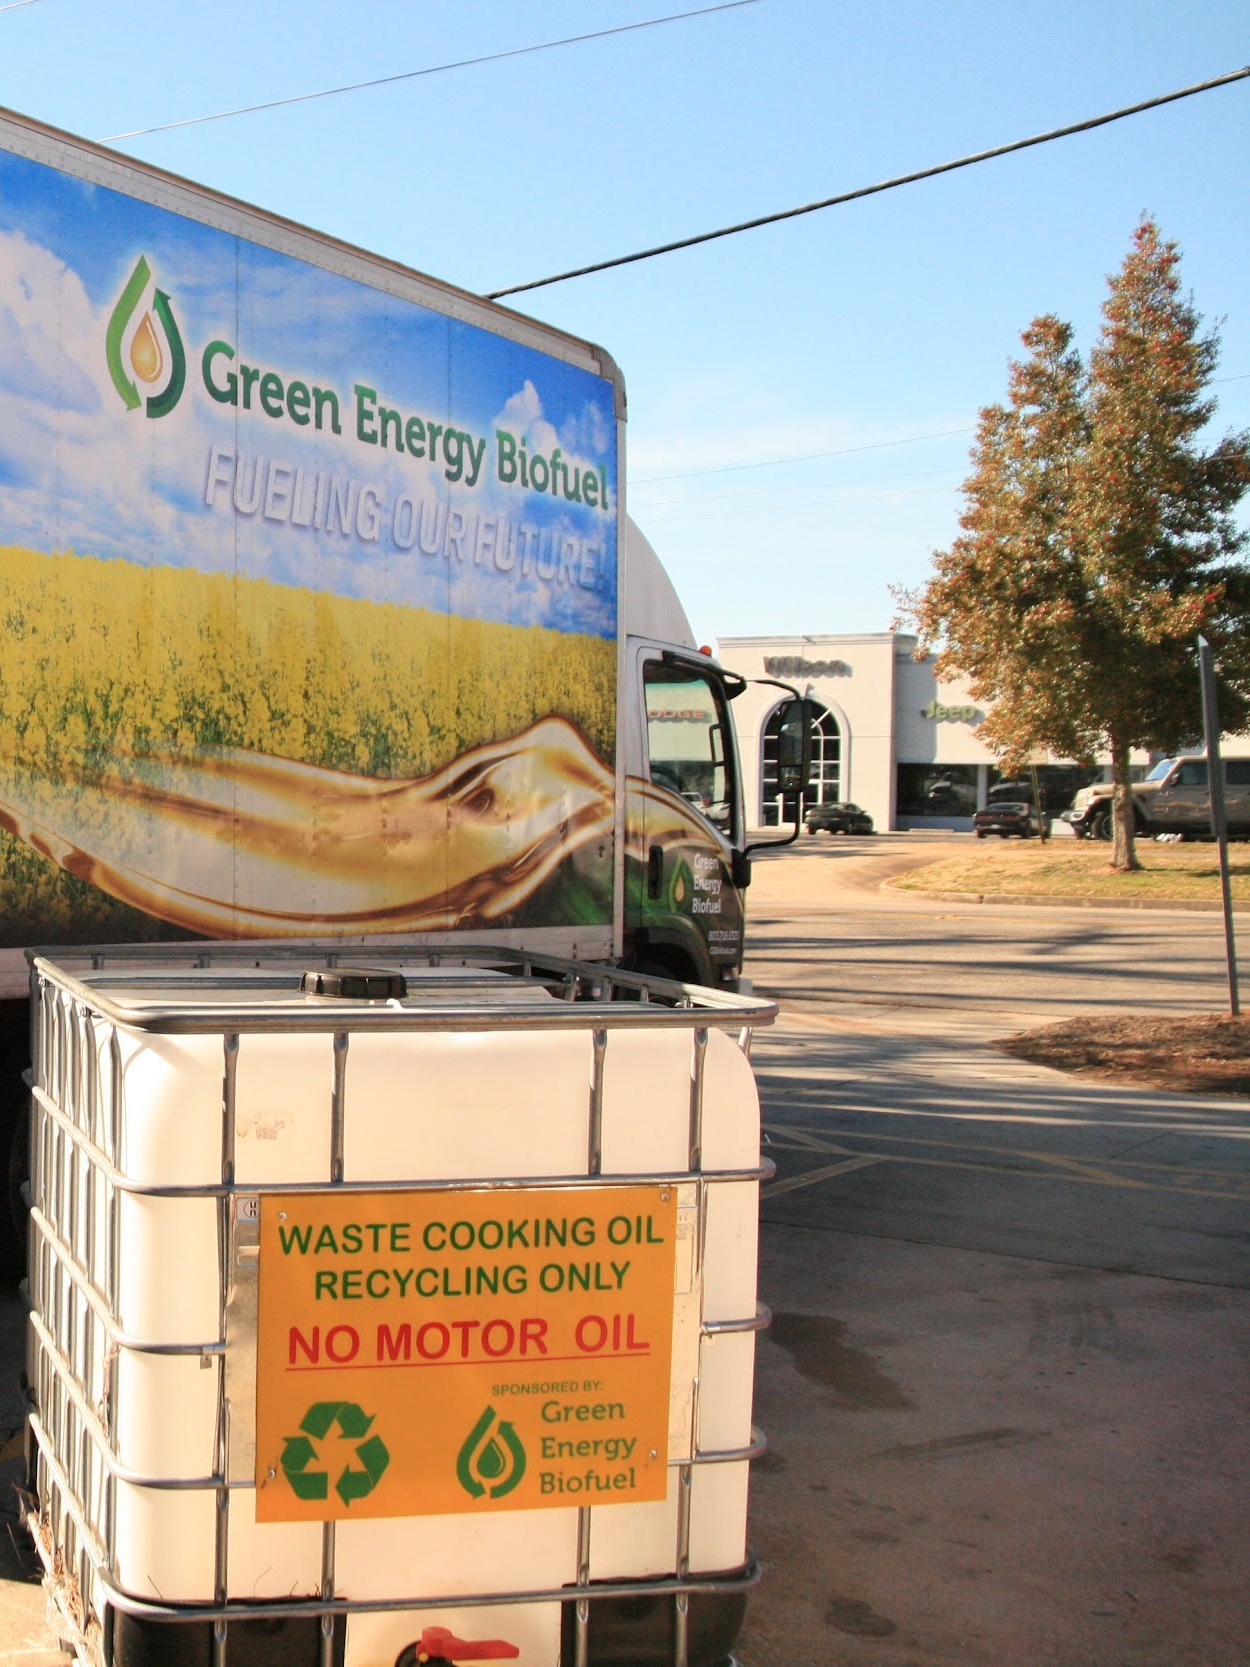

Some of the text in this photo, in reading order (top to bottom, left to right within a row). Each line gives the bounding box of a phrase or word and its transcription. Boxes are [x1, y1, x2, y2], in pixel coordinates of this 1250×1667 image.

[202, 340, 610, 511] Green Energy Biofuel
[204, 444, 608, 593] FUELING OUR FUTURE!
[647, 707, 705, 719] ODGE
[926, 700, 976, 719] Jeep
[694, 853, 719, 870] Green
[693, 874, 722, 895] Energy
[692, 897, 722, 914] Biofuel
[278, 1223, 411, 1255] WASTE
[423, 1216, 596, 1251] COOKING
[607, 1214, 664, 1246] OIL
[314, 1261, 630, 1300] RECYCLING ONLY
[288, 1313, 650, 1364] NO MOTOR OIL
[491, 1380, 604, 1397] SPONSORED BY:
[540, 1400, 625, 1426] Green
[540, 1434, 638, 1461] Energy
[538, 1467, 636, 1496] Biofuel
